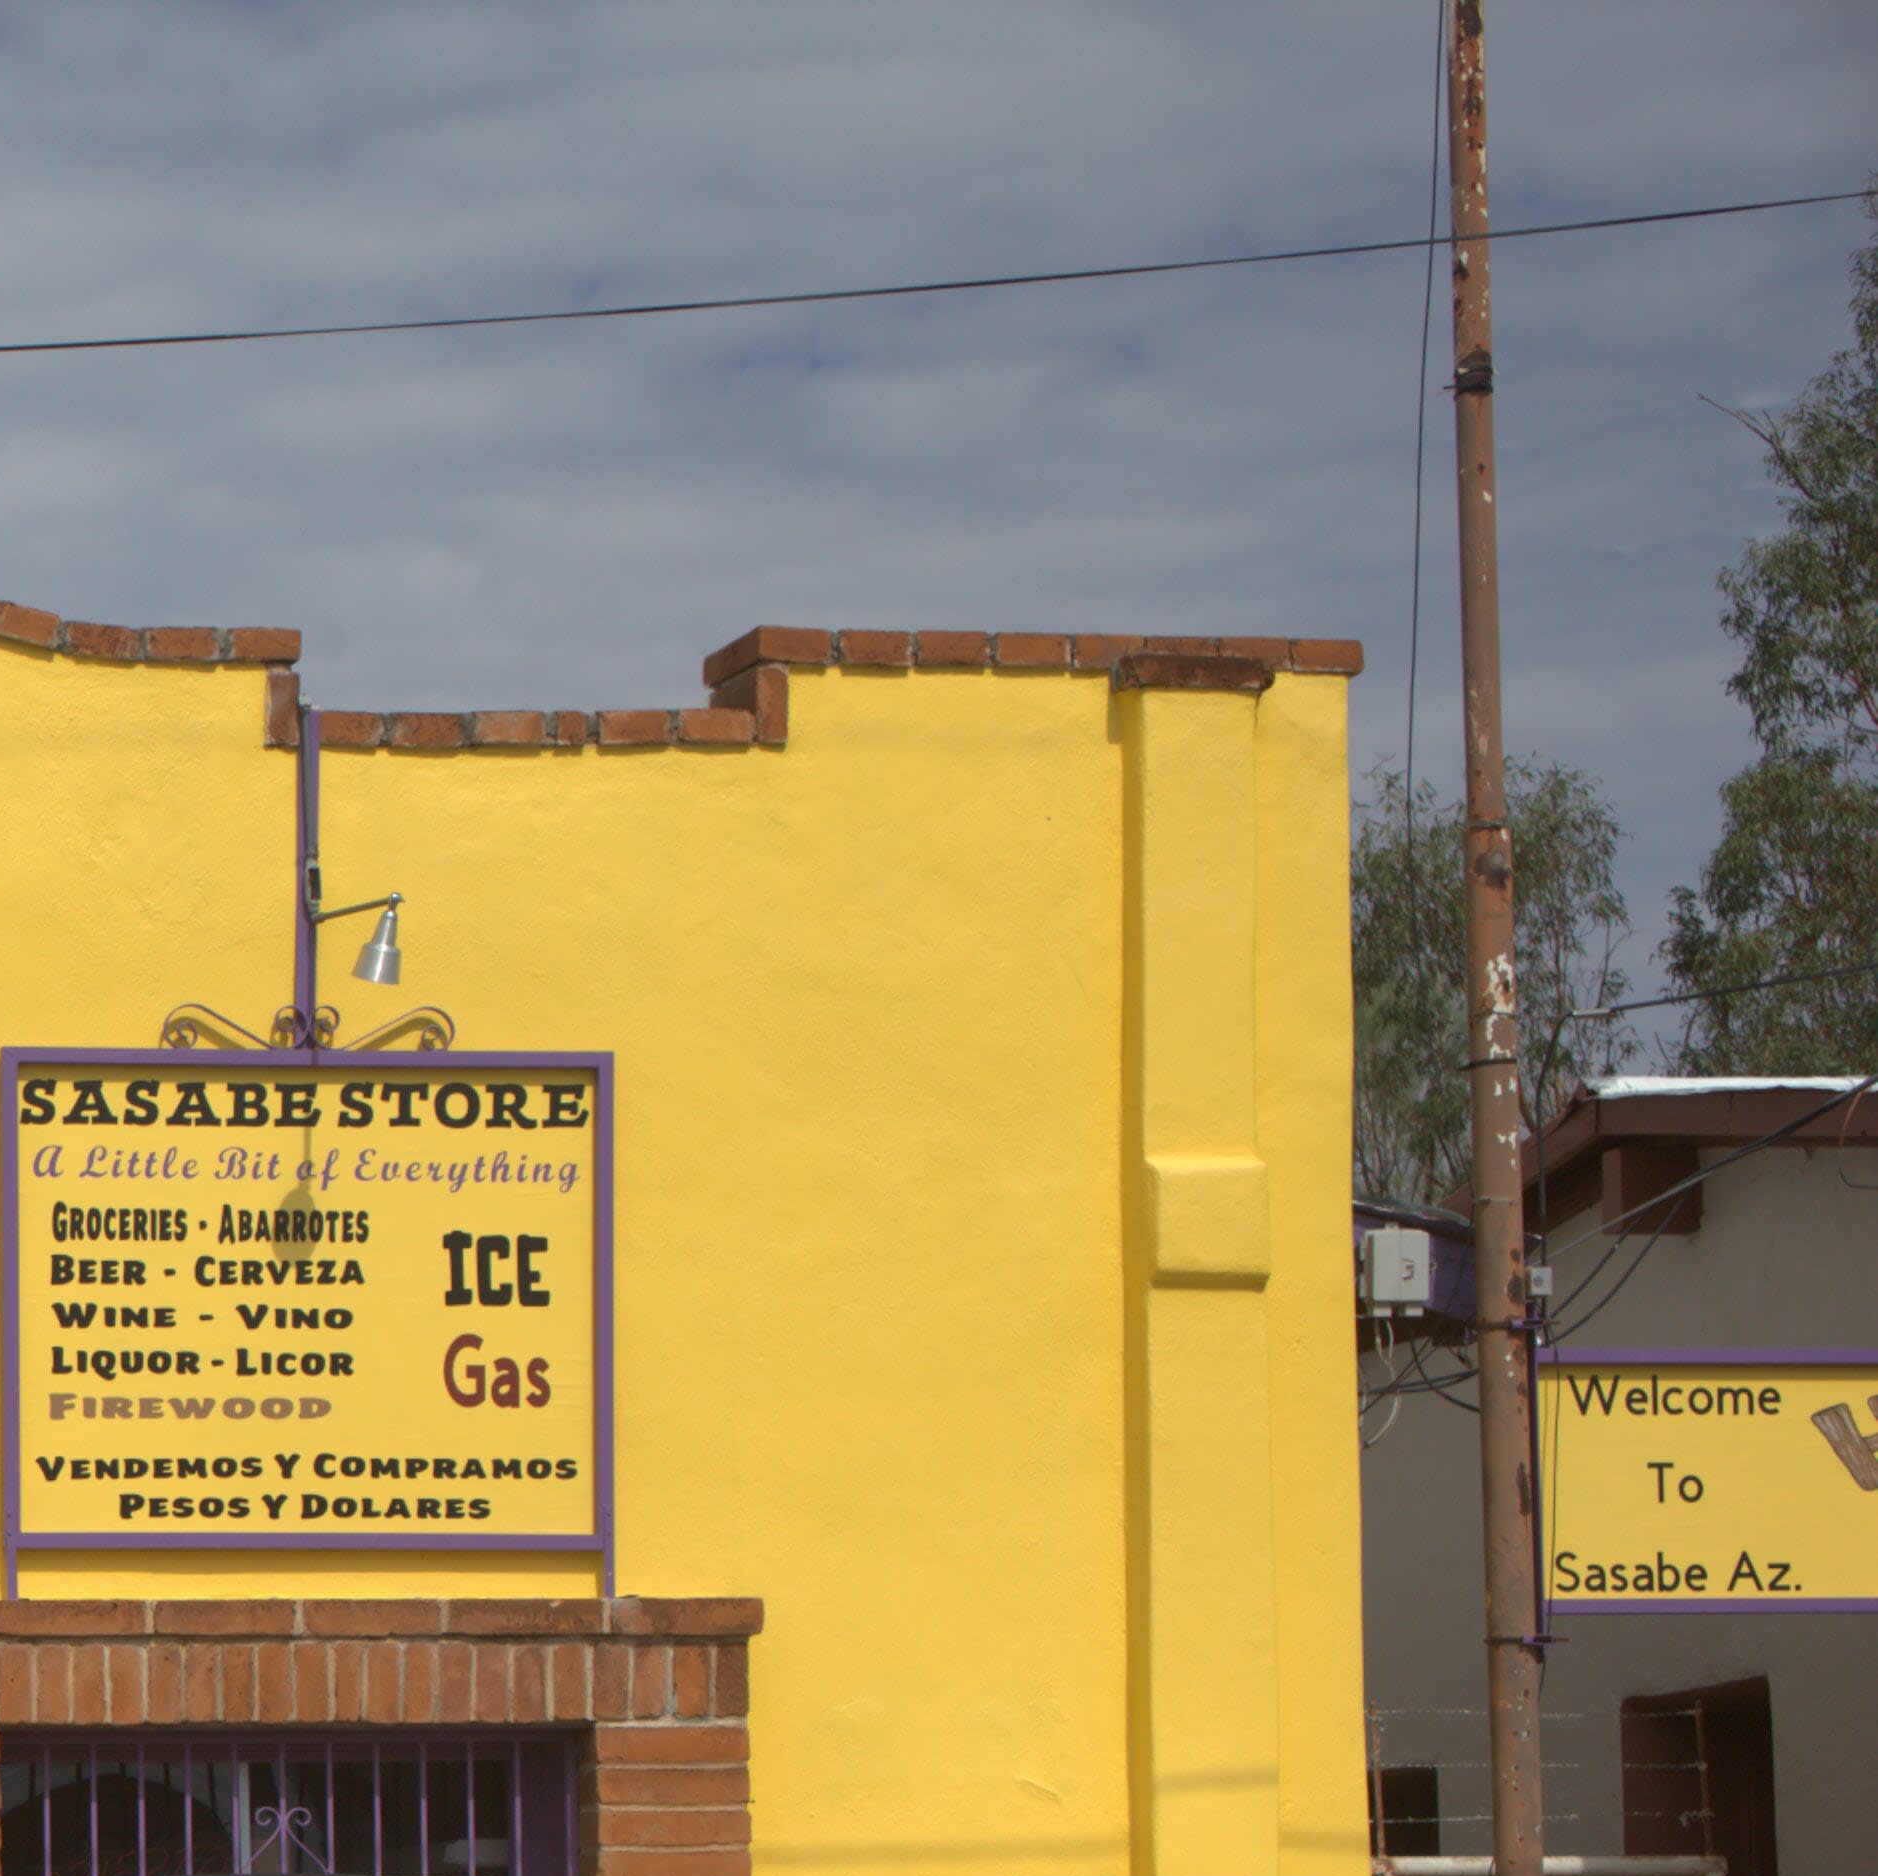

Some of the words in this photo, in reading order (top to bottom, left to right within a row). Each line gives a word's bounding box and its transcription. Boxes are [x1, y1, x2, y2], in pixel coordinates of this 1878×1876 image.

[20, 1079, 322, 1127] SASABE
[337, 1081, 589, 1128] STORE
[32, 1145, 64, 1179] A
[79, 1146, 200, 1180] Little
[214, 1146, 281, 1181] Bit
[296, 1148, 341, 1191] of
[354, 1151, 580, 1193] Everything
[51, 1201, 188, 1243] GROCERIES
[218, 1204, 370, 1245] ABARROTES
[50, 1255, 147, 1286] BEER
[194, 1256, 365, 1287] CERVEZA
[442, 1230, 550, 1307] ICE
[52, 1303, 177, 1328] WINE
[236, 1304, 354, 1329] VINO
[51, 1346, 200, 1381] LIQUOR
[235, 1349, 354, 1376] LICOR
[443, 1334, 552, 1409] Gas
[48, 1393, 332, 1420] FIREWOOD
[1567, 1374, 1781, 1416] Welcome
[36, 1455, 263, 1480] VENDEMOS
[274, 1455, 301, 1479] Y
[312, 1455, 578, 1480] COMPRAMOS
[1647, 1462, 1704, 1503] To
[119, 1494, 250, 1520] PESOS
[261, 1495, 288, 1520] Y
[300, 1495, 491, 1520] DOLARES
[1555, 1552, 1708, 1592] Sasabe
[1727, 1551, 1802, 1592] Az.
